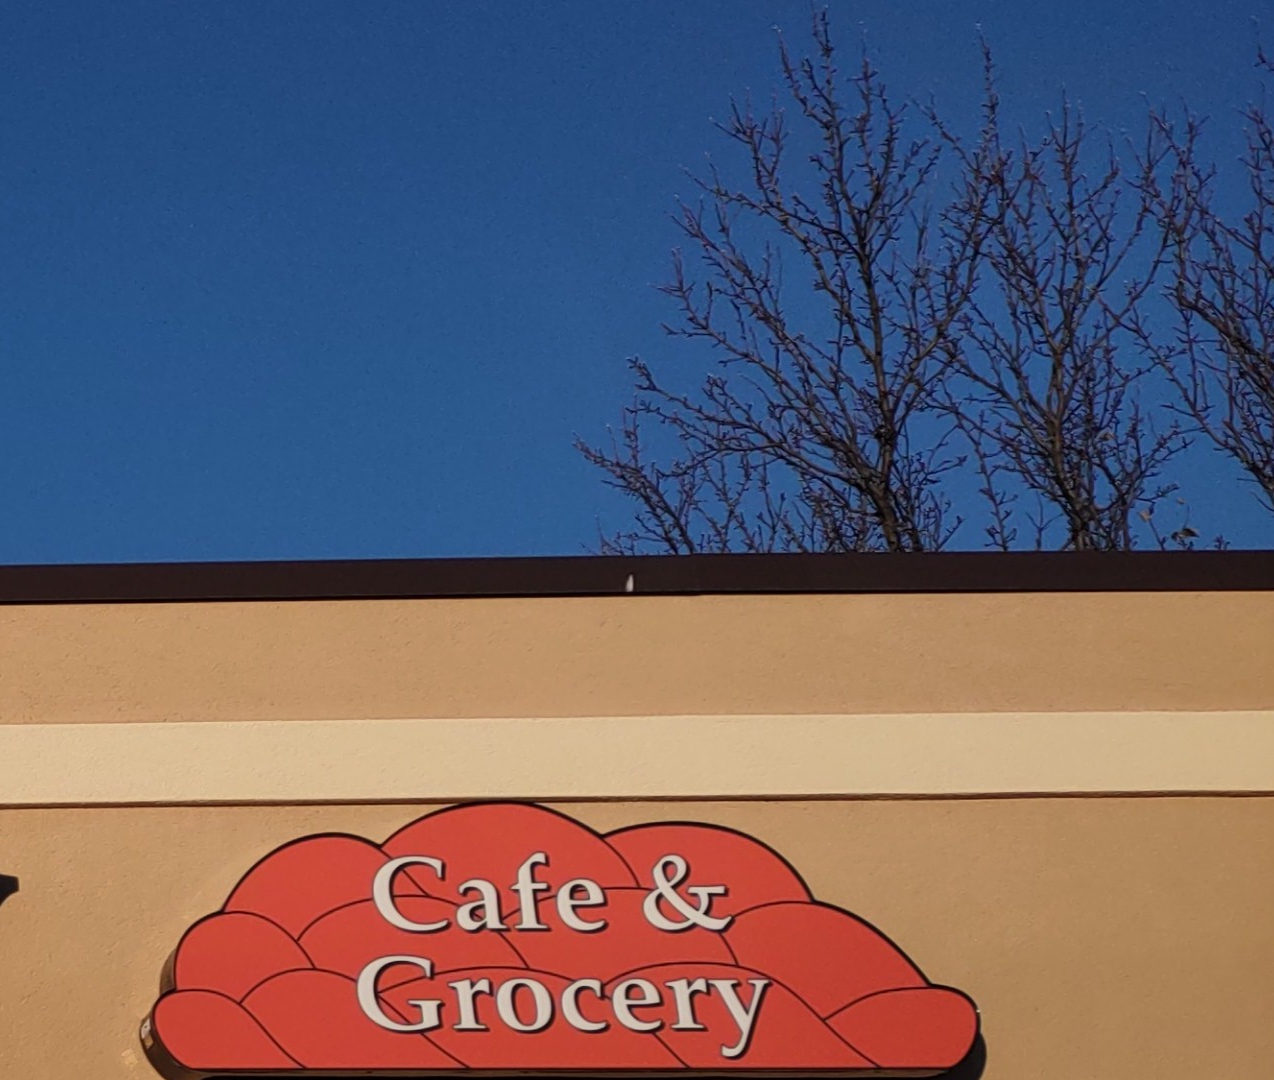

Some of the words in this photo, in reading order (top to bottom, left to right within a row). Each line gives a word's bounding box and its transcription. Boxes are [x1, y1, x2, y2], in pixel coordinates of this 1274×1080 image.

[371, 851, 609, 934] Cafe
[642, 853, 734, 933] &
[355, 954, 772, 1060] Grocery
